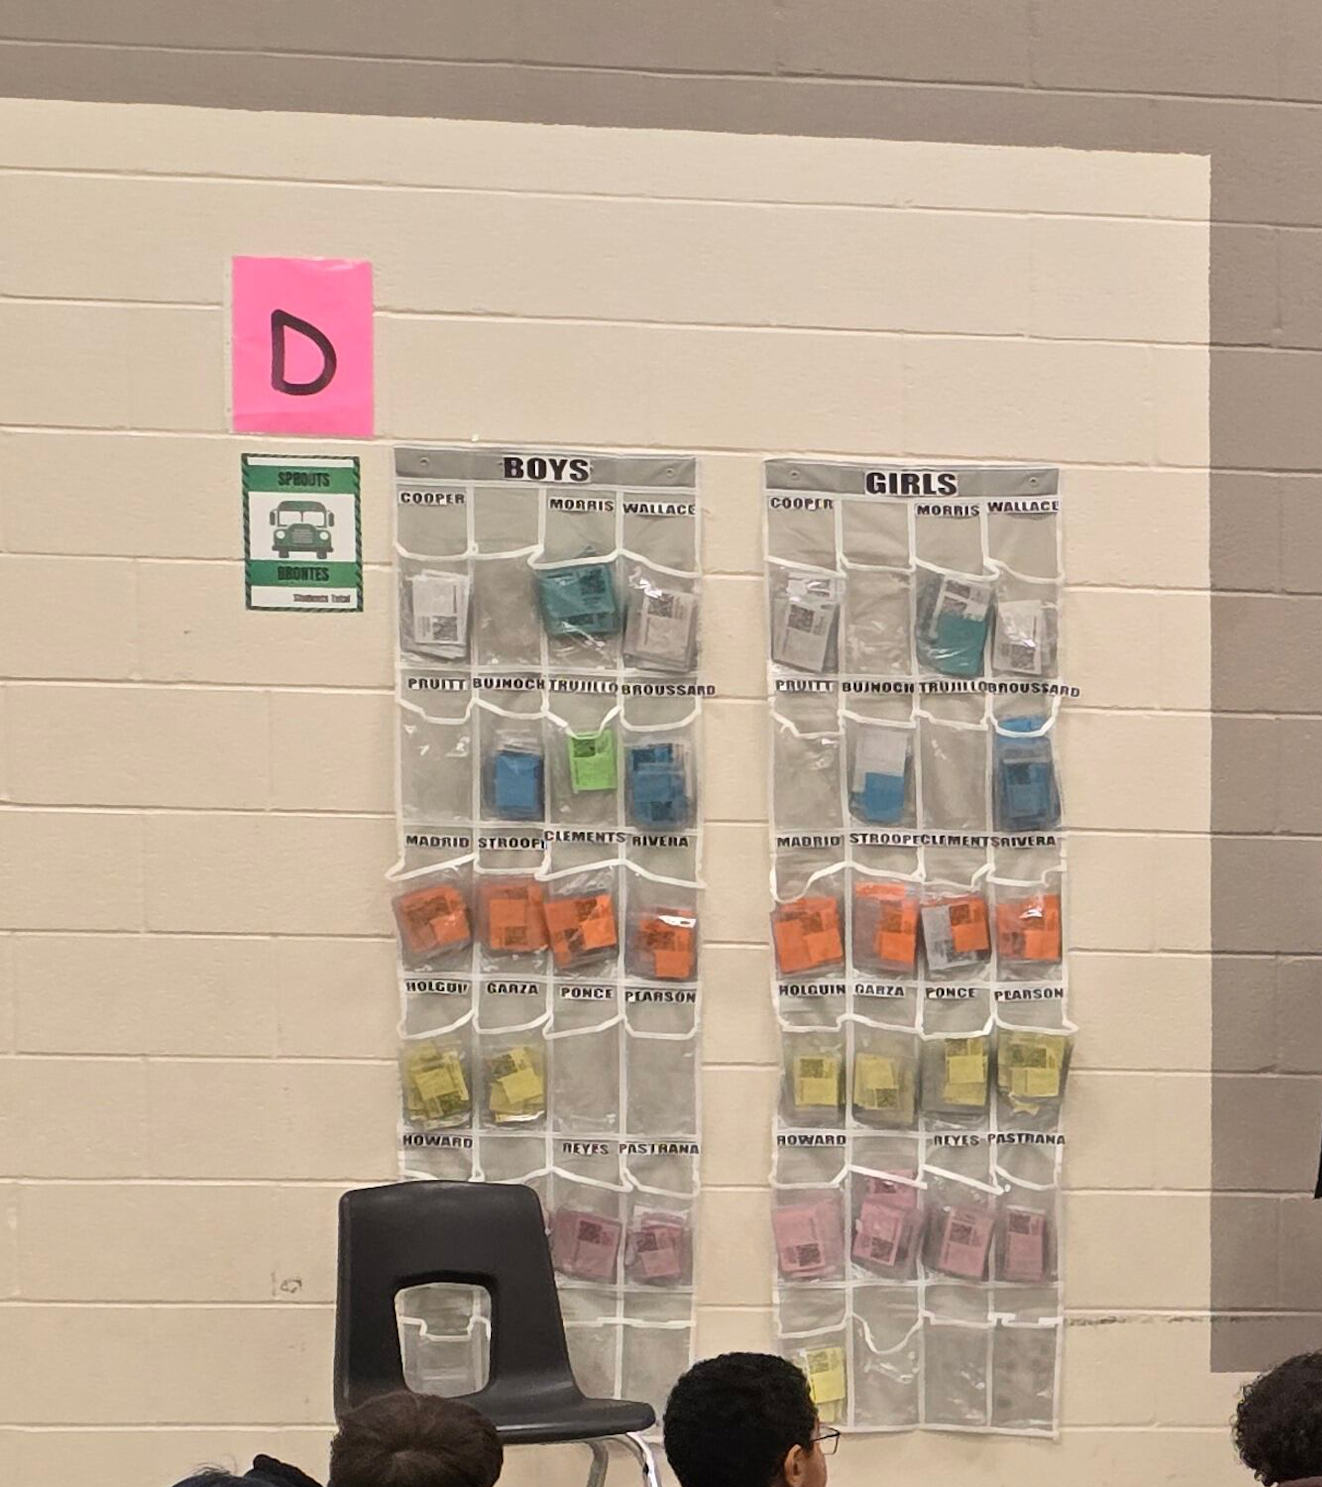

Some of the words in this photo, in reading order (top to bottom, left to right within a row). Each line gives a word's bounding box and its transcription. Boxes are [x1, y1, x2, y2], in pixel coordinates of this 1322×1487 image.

[271, 308, 338, 396] D
[503, 456, 590, 482] BOYS
[866, 471, 957, 495] GIRLS
[400, 491, 465, 506] COOPER
[549, 497, 614, 512] MORRIS
[770, 497, 833, 511] COOPER
[622, 502, 696, 516] WALLACE
[916, 504, 980, 518] MORRIS
[987, 500, 1059, 513] WALLACE
[408, 678, 466, 690] PRUITT
[621, 684, 717, 697] BROUSSARD
[776, 679, 833, 692] PRUITT
[988, 682, 1081, 698] BROUSSARD
[405, 835, 470, 849] MADRID
[543, 830, 626, 843] CLEMENTS
[631, 835, 689, 848] RIVERA
[777, 836, 841, 848] MADRID
[486, 983, 539, 996] GARZA
[561, 987, 614, 999] PONCE
[779, 984, 846, 997] HOLGUIN
[855, 985, 905, 998] GARZA
[926, 986, 977, 999] PONCE
[994, 987, 1065, 1001] PEARSON
[624, 990, 697, 1004] PEARSON
[402, 1134, 473, 1149] HOWARD
[777, 1133, 846, 1147] HOWARD
[934, 1133, 980, 1147] REYES
[987, 1132, 1067, 1146] PASTRANA
[562, 1142, 610, 1156] REYES
[618, 1142, 700, 1156] PASTRANA
